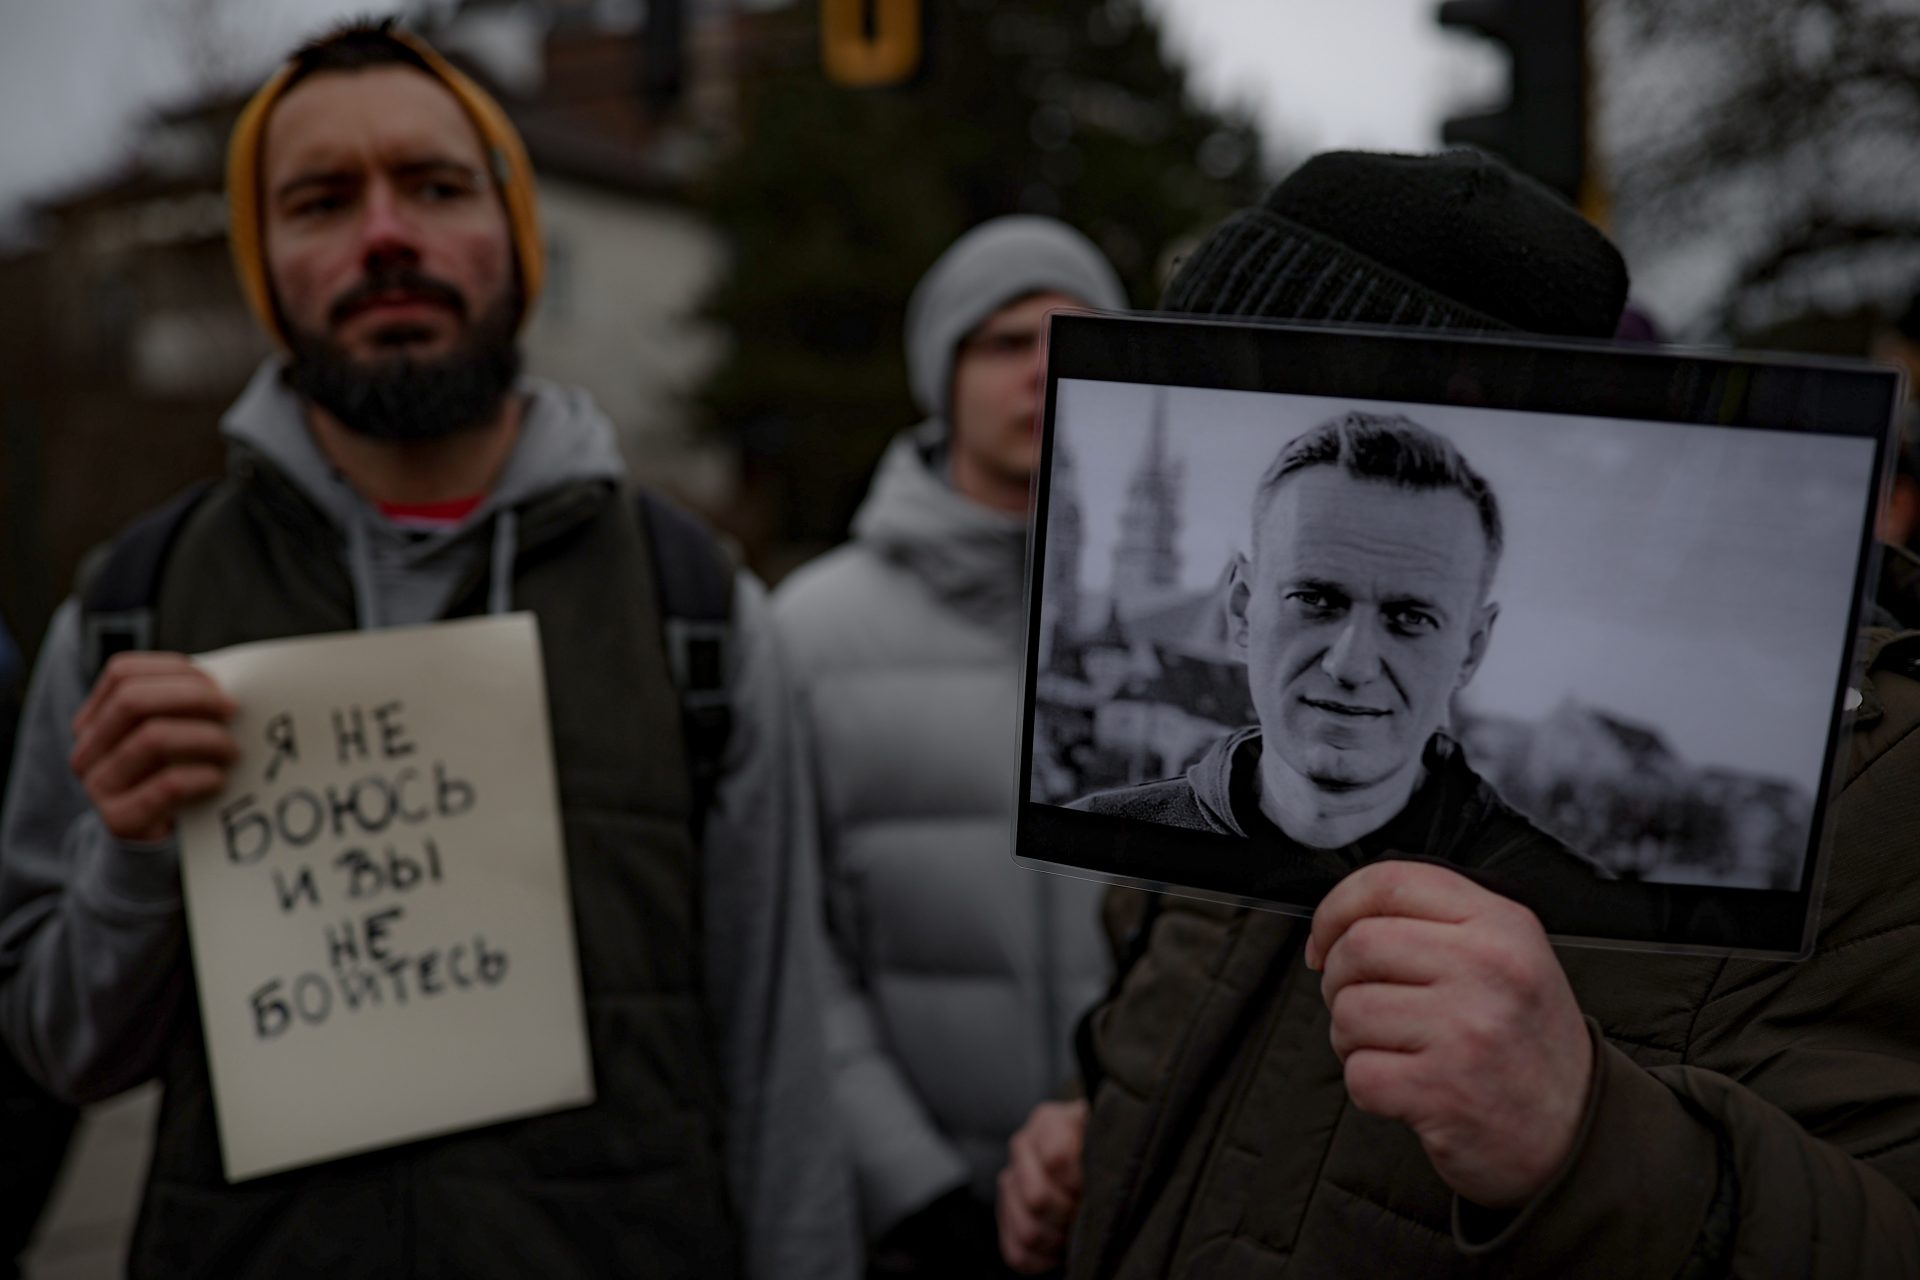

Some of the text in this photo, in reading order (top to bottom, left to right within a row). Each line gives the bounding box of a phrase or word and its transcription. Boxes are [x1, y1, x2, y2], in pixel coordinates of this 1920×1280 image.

[263, 702, 416, 783] Я НЕ
[220, 761, 476, 864] БОЮСЬ
[272, 836, 442, 914] И ВЫ
[325, 906, 406, 968] НЕ
